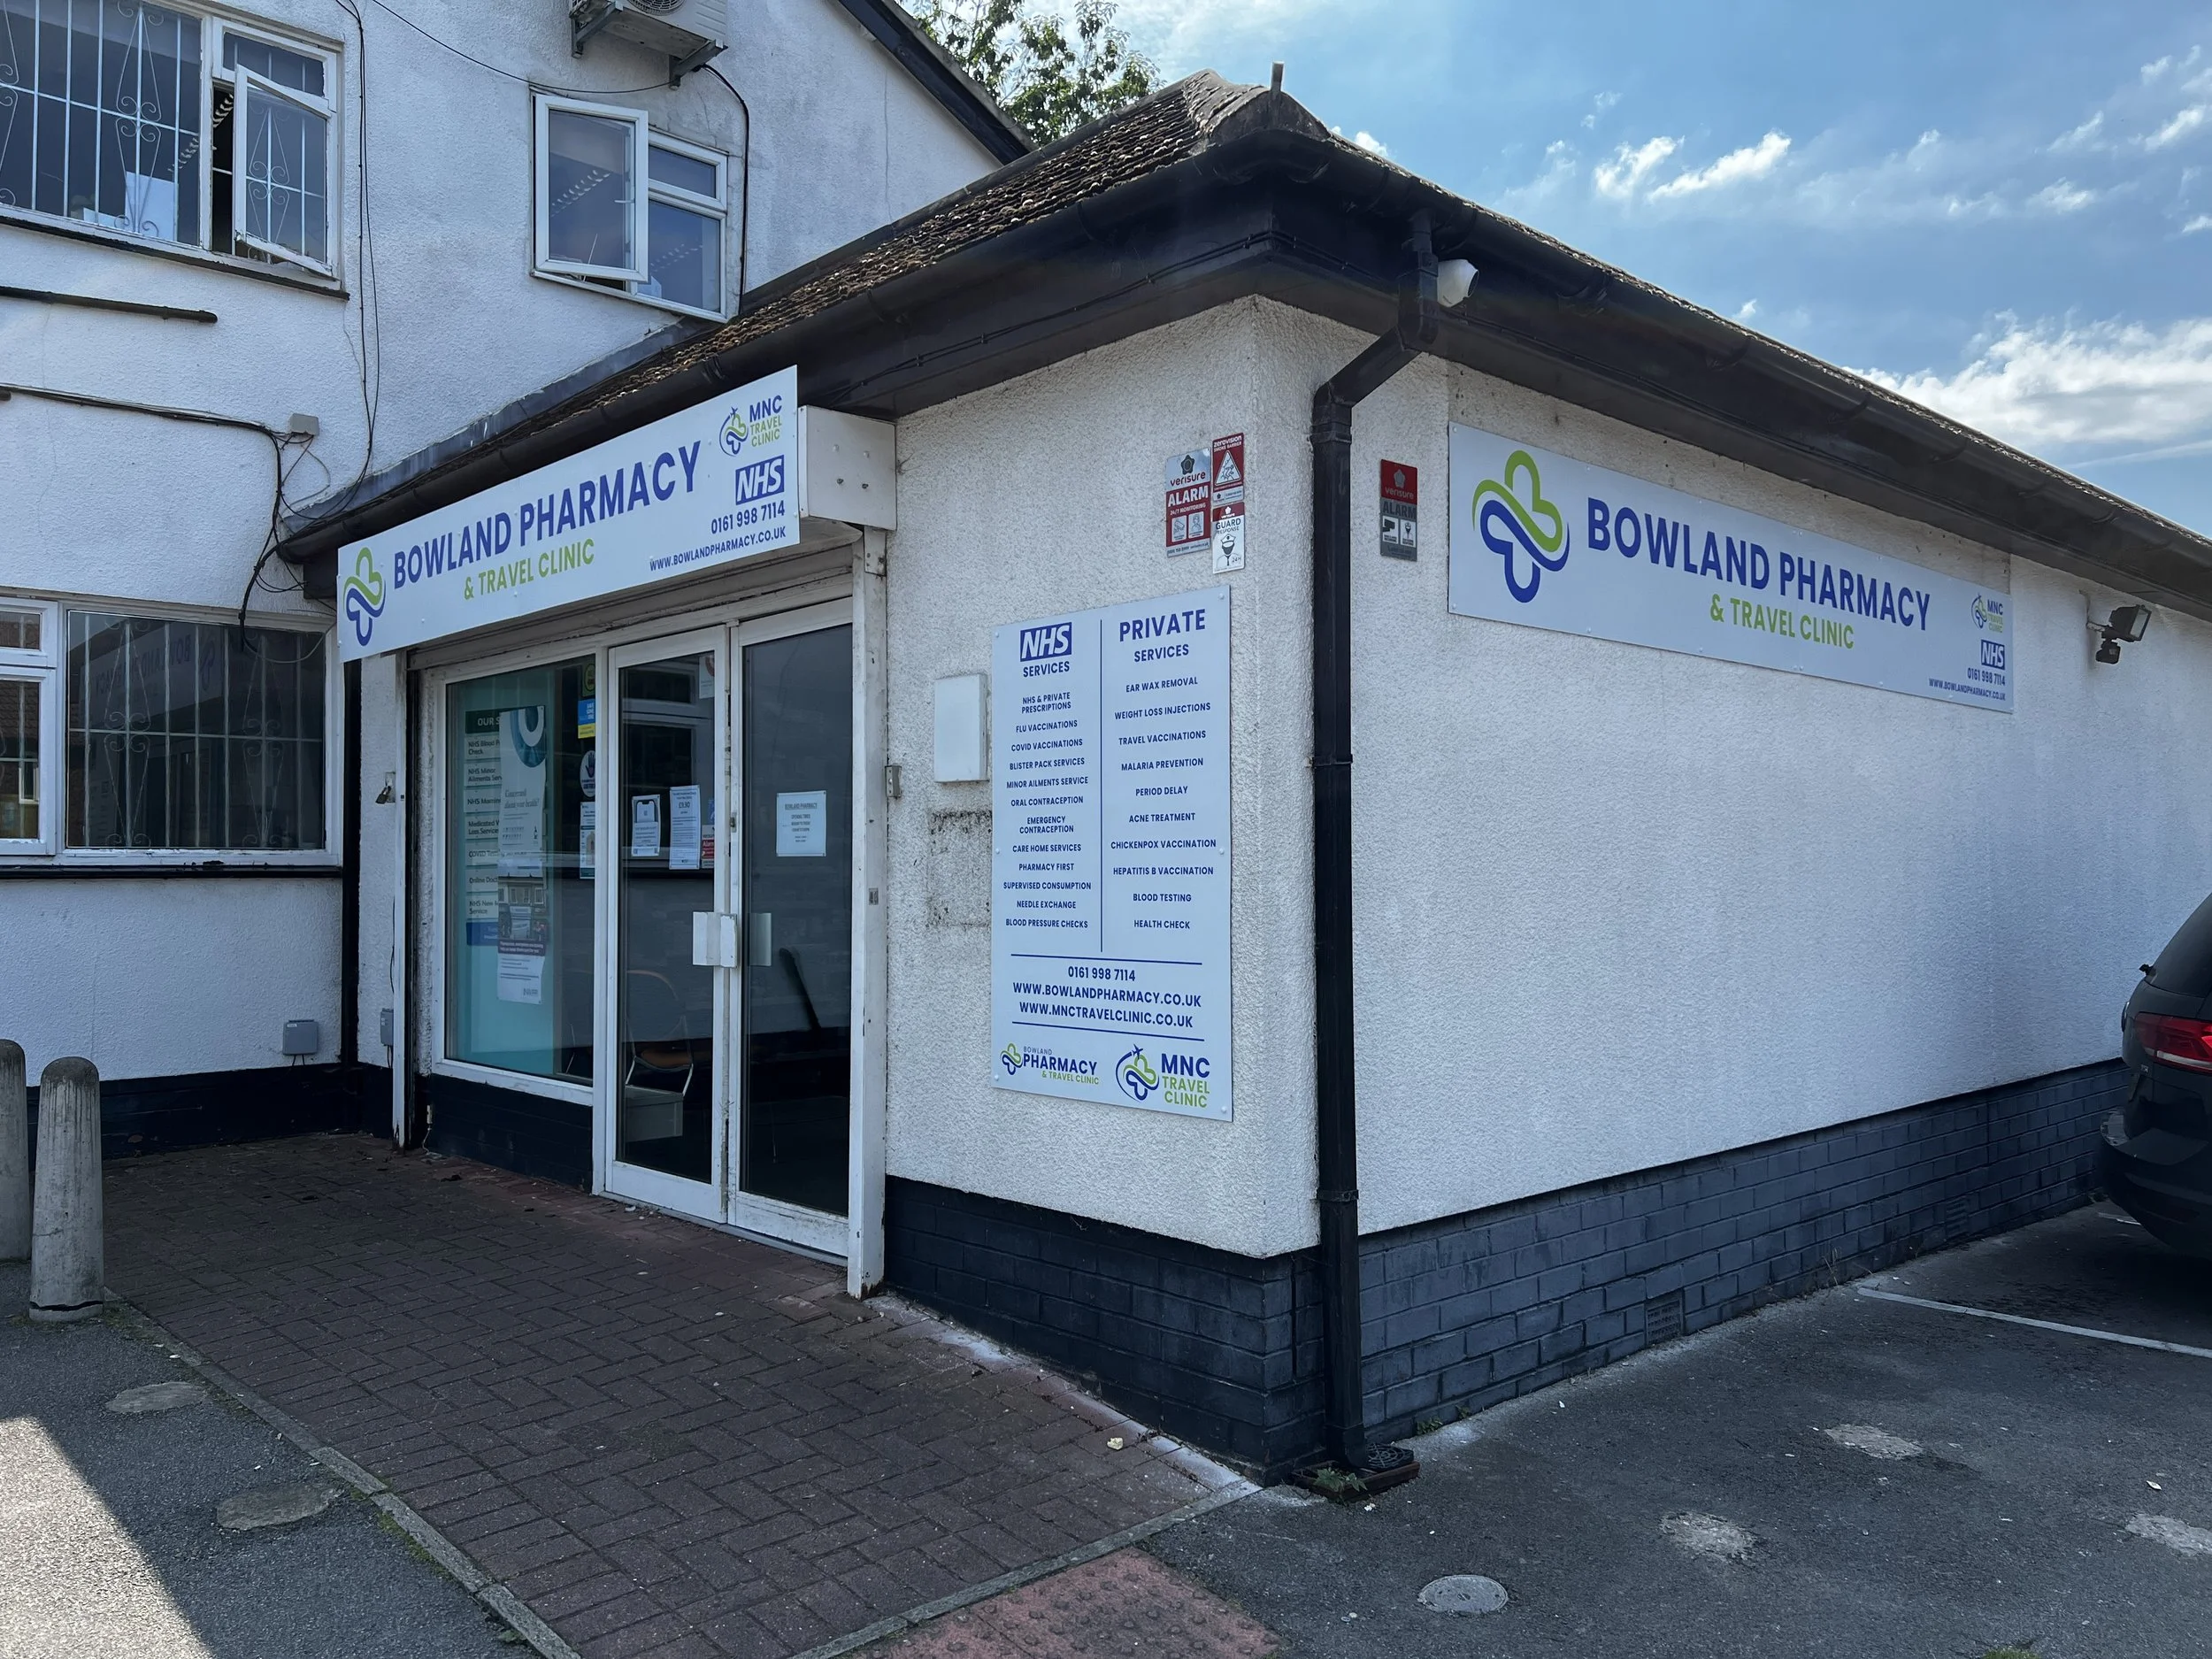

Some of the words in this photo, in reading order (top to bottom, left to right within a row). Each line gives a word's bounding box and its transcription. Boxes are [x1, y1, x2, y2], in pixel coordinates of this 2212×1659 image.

[749, 395, 782, 422] MNC
[750, 416, 782, 436] TRAVEL
[751, 428, 780, 447] CLINIC
[1214, 435, 1241, 448] zerovision
[735, 455, 784, 504] NHS
[1171, 472, 1205, 487] verisure
[1168, 485, 1208, 507] ALARM
[1385, 487, 1414, 499] verisure
[393, 511, 511, 589] BOWLAND
[518, 439, 701, 546] PHARMACY
[711, 515, 733, 534] 0161
[737, 508, 757, 526] 998
[761, 501, 785, 520] 7114
[1383, 501, 1417, 519] ALARM
[1216, 518, 1241, 530] GUARD
[650, 524, 787, 573] WWW.BOWLANDPHARMACY.CO.UK
[465, 577, 473, 600] &
[479, 562, 534, 597] TRAVEL
[537, 538, 594, 578] CLINIC
[1588, 497, 1770, 589] BOWLAND
[1780, 550, 1930, 632] PHARMACY
[1987, 599, 2003, 615] MNC
[1120, 609, 1205, 641] PRIVATE
[1710, 594, 1724, 622] &
[1731, 598, 1795, 637] TRAVEL
[1800, 615, 1854, 649] CLINIC
[1020, 622, 1072, 662] NHS
[1134, 644, 1188, 662] SERVICES
[1981, 640, 2005, 670] NHS
[1022, 660, 1069, 677] SERVICES
[1968, 668, 1980, 680] 0161
[1982, 671, 1993, 683] 998
[1994, 674, 2005, 686] 7114
[1162, 677, 1197, 687] REMOVAL
[1929, 678, 2005, 701] WWW.BOWLANDPHARMACY.CO.UK
[1022, 701, 1071, 713] PRESCRIPTIONS
[1023, 696, 1035, 706] NHS
[1044, 692, 1071, 703] PRIVATE
[1115, 710, 1142, 719] WEIGHT
[1145, 708, 1163, 717] LOSS
[1165, 703, 1210, 714] INJECTIONS
[478, 717, 495, 726] OUR
[1028, 720, 1077, 731] VACCINATIONS
[1033, 739, 1082, 749] VACCINATIONS
[1119, 736, 1145, 745] TRAVEL
[1148, 731, 1205, 742] VACCINATIONS
[1054, 757, 1084, 766] SERVICES
[1122, 762, 1154, 771] MALARIA
[1156, 758, 1202, 768] PREVENTION
[1164, 786, 1187, 795] DELAY
[1029, 796, 1083, 805] CONTRACEPTION
[1069, 966, 1088, 978] 0161
[1092, 968, 1110, 979] 998
[1114, 969, 1135, 981] 7114
[1013, 980, 1201, 1009] WWW.BOWLANDPHARMACY.CO.UK
[1018, 1001, 1193, 1028] WWW.MNCTRAVELCLINIC.CO.UK
[1024, 1047, 1052, 1056] BOWLAND
[1024, 1053, 1097, 1076] PHARMACY
[1162, 1054, 1210, 1079] MNC
[1048, 1071, 1073, 1081] TRAVEL
[1076, 1073, 1099, 1084] CLINIC
[1162, 1076, 1210, 1095] TRAVEL
[1164, 1089, 1209, 1108] CLINIC
